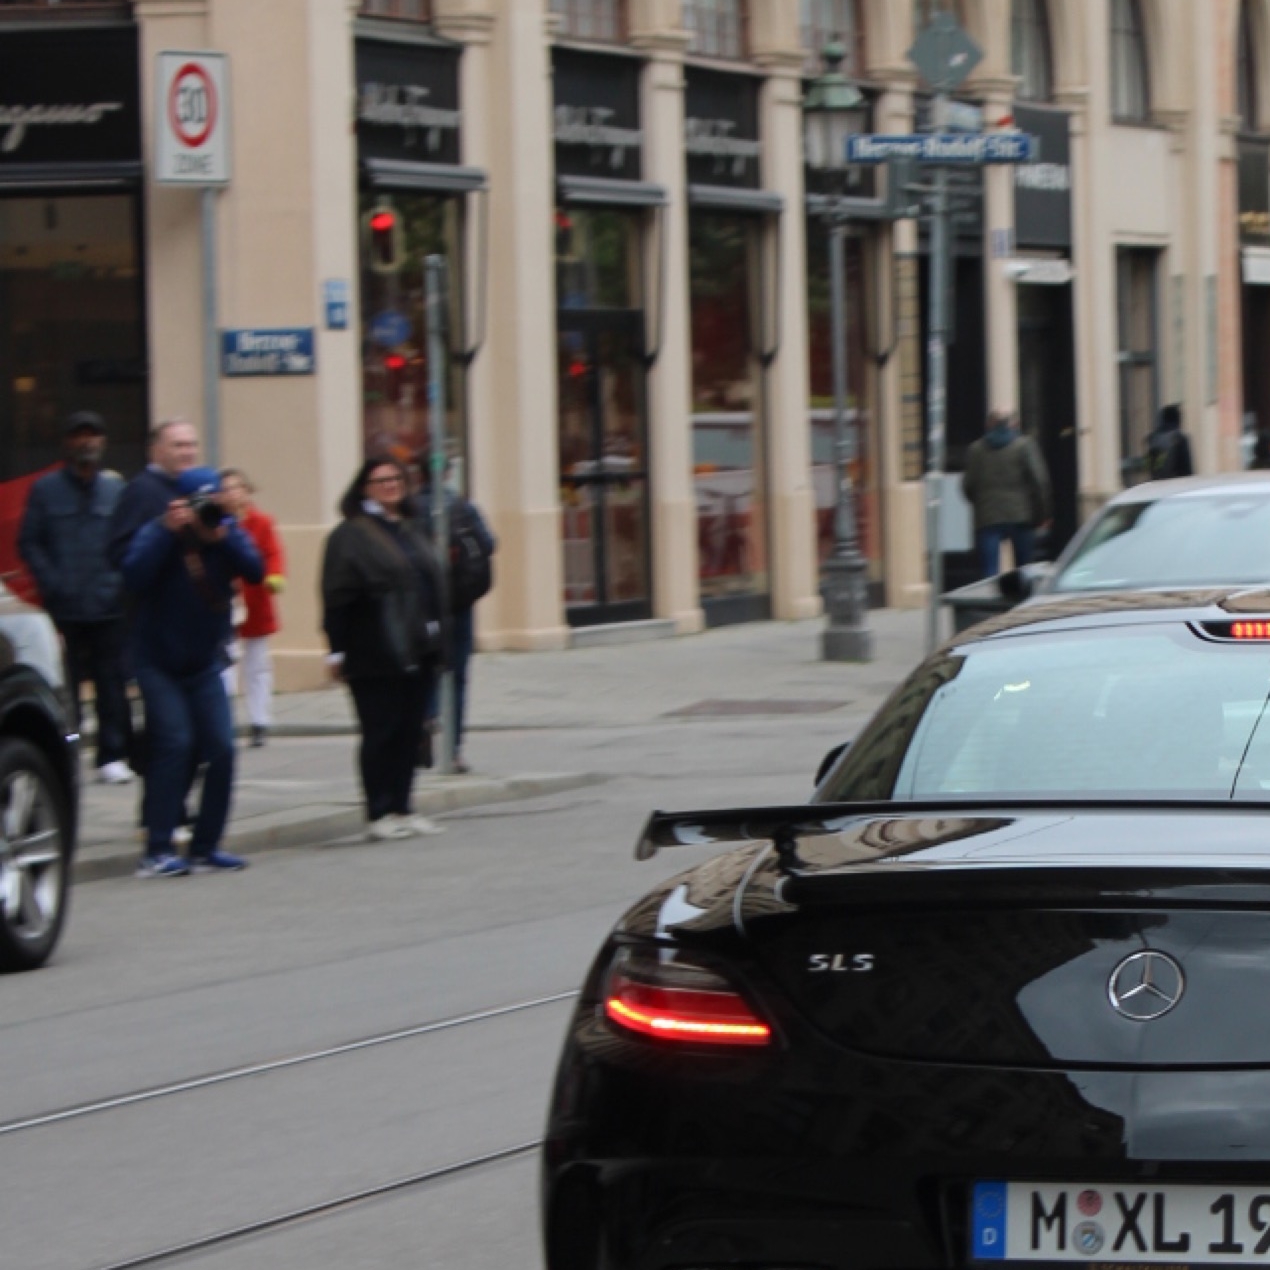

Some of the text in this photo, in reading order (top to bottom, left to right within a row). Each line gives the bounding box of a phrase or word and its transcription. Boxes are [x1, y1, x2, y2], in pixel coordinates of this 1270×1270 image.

[807, 953, 875, 972] SLS
[982, 1228, 997, 1245] D
[1031, 1191, 1066, 1251] M
[1112, 1192, 1190, 1254] XL
